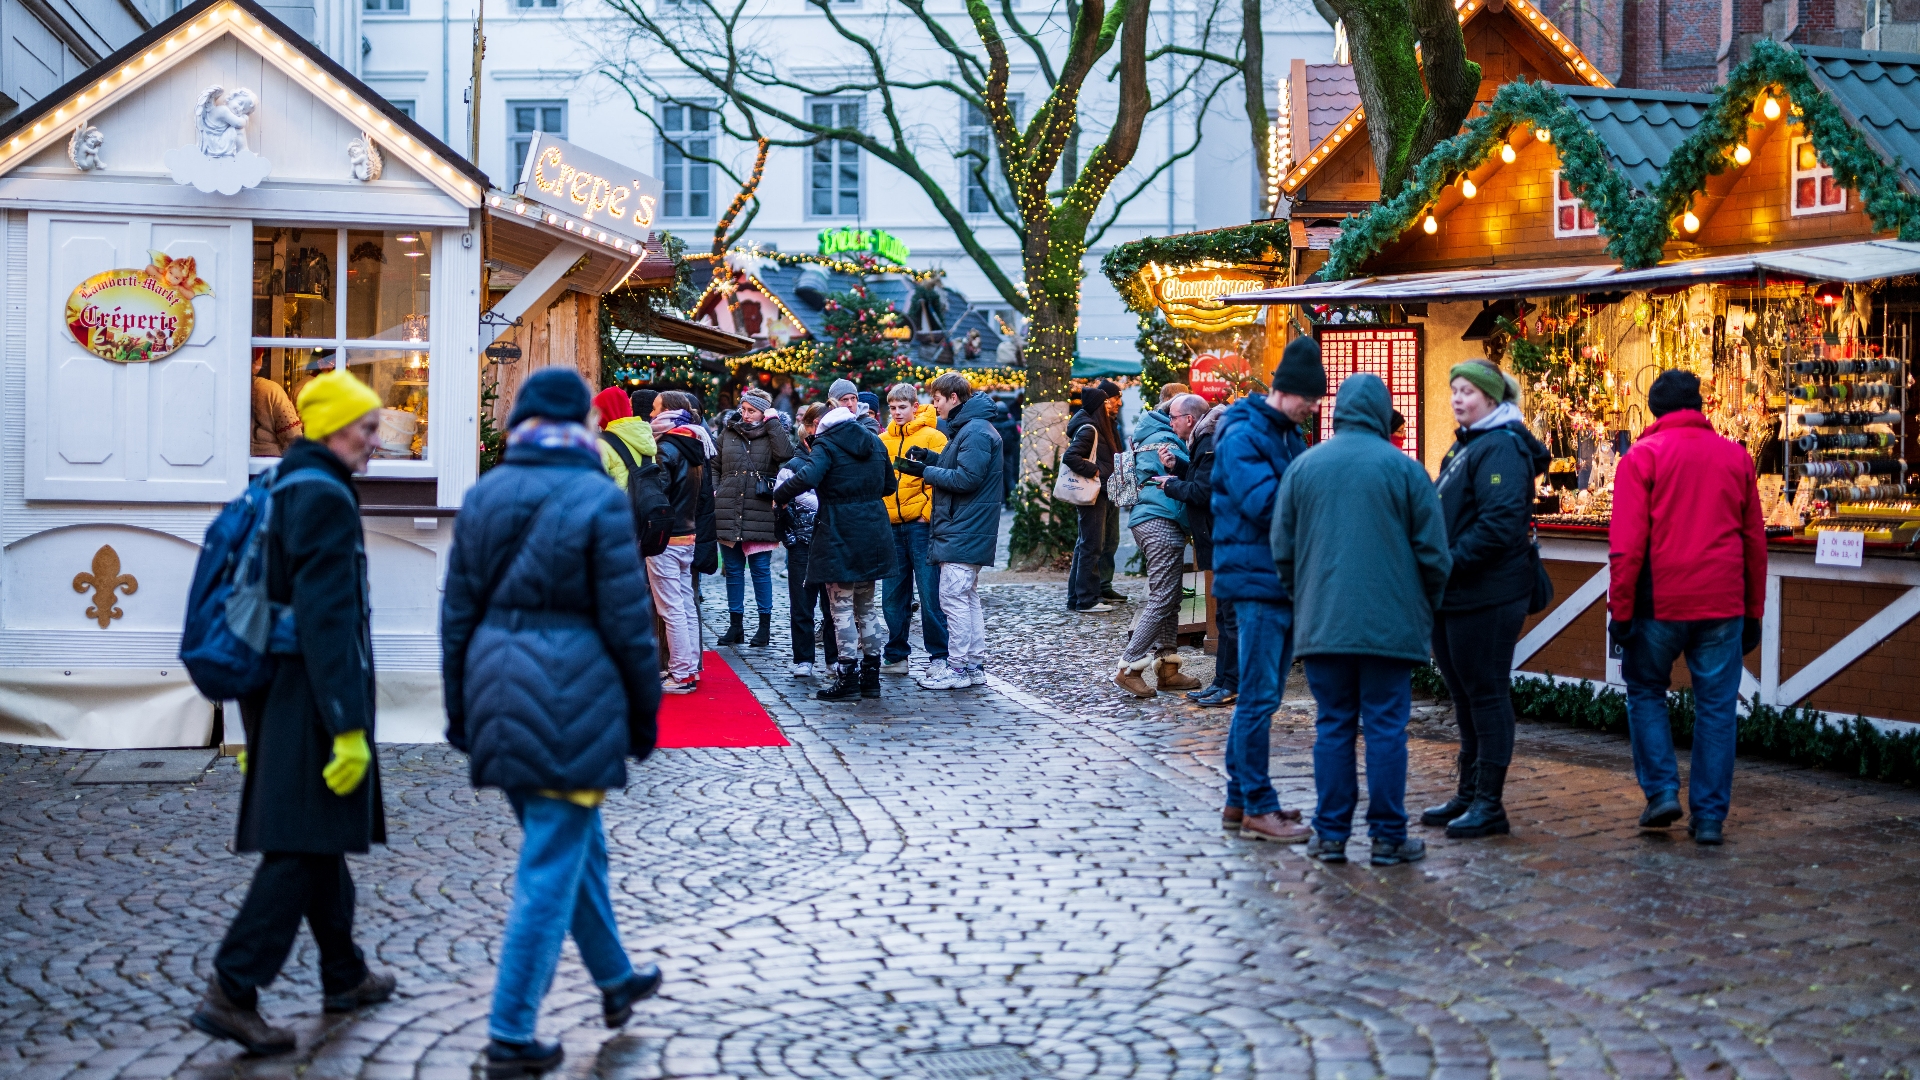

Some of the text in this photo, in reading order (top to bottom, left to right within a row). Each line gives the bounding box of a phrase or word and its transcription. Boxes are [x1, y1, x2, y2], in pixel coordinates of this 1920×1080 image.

[536, 146, 656, 228] Crepe's
[79, 276, 180, 307] Lamberti-Markt
[80, 304, 178, 333] Créperie
